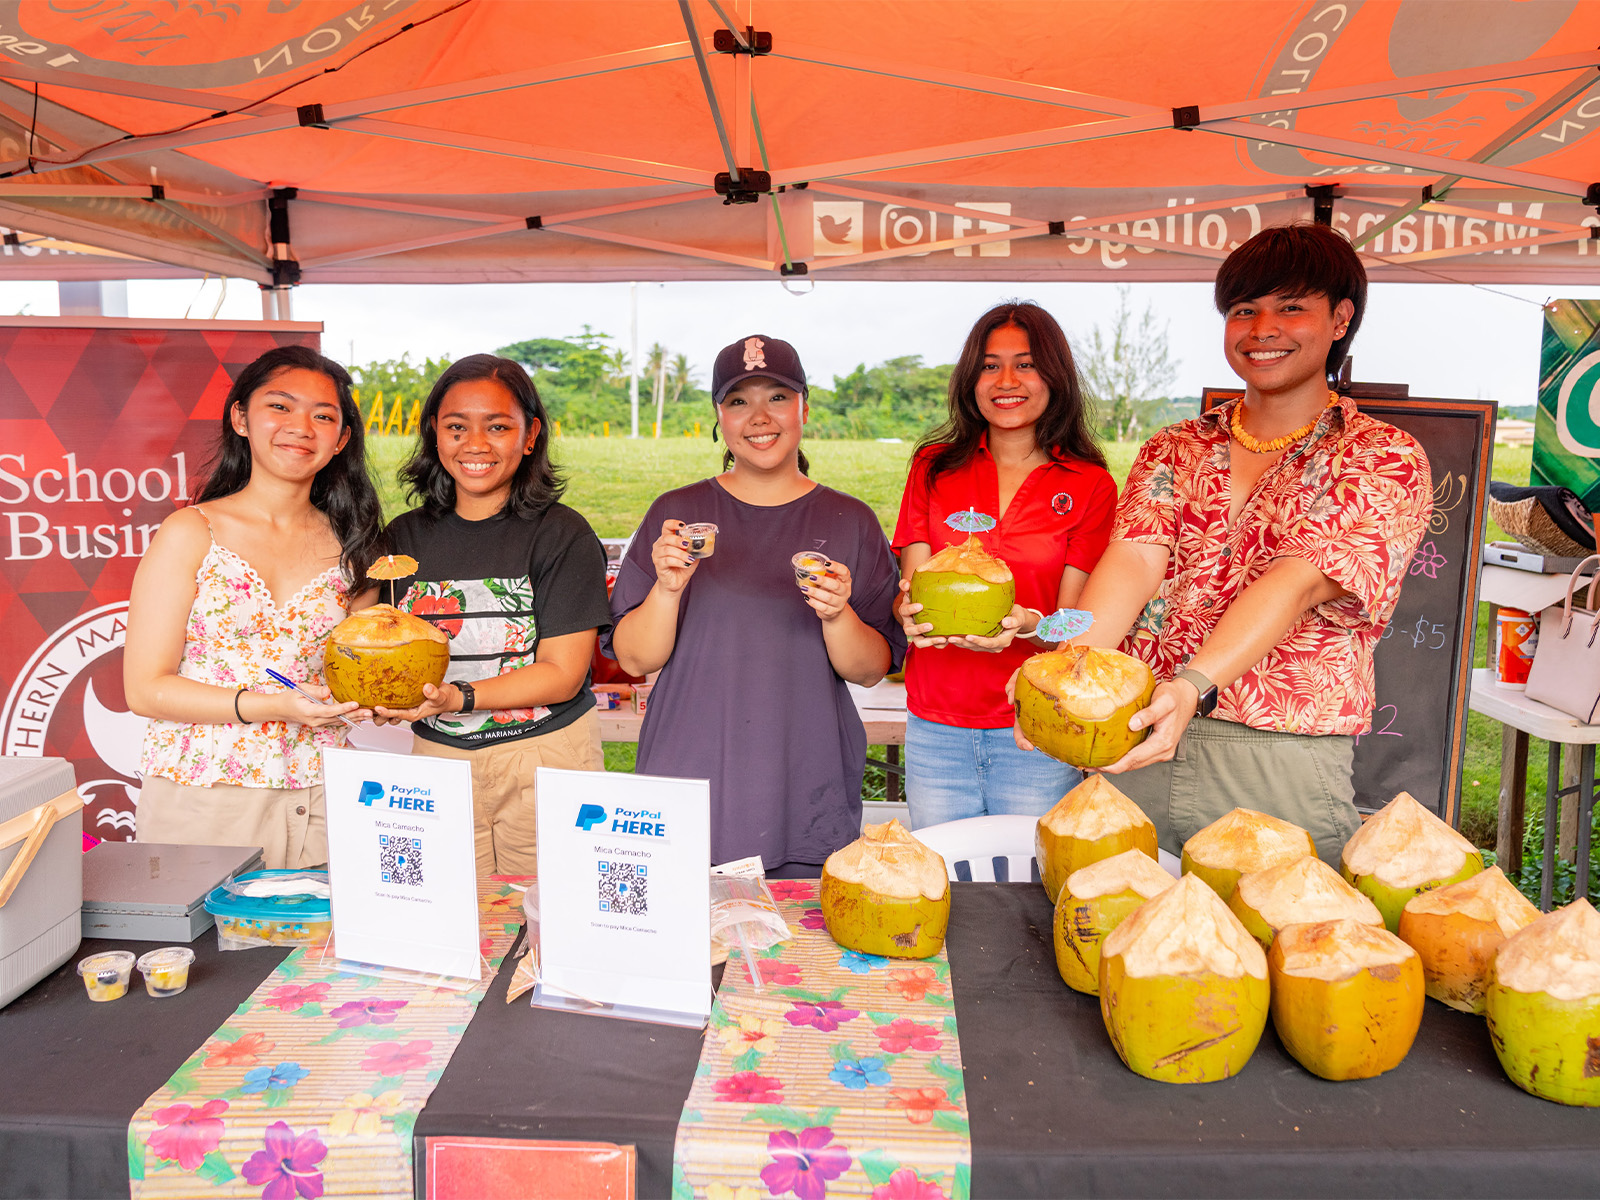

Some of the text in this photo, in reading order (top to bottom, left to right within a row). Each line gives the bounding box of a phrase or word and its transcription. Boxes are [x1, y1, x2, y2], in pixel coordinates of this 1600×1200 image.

[0, 452, 192, 504] School
[14, 663, 69, 757] HERN
[391, 784, 431, 796] PayPal
[389, 795, 435, 812] HERE
[615, 807, 661, 820] PayPal
[375, 820, 425, 833] Mica Camacho
[611, 819, 665, 837] HERE
[594, 845, 652, 858] Mica Camacho
